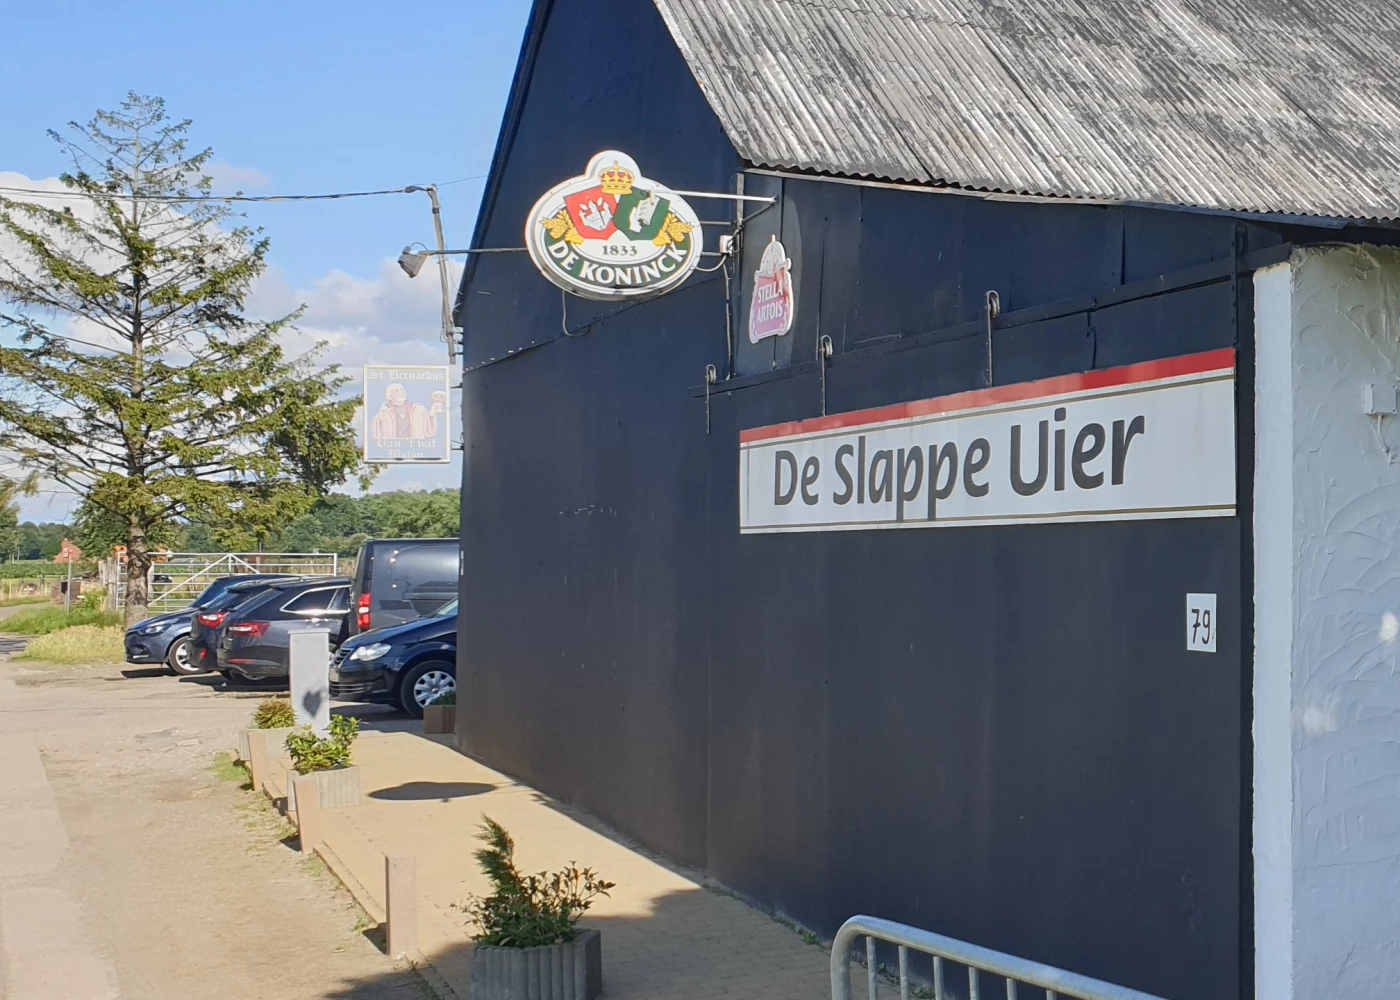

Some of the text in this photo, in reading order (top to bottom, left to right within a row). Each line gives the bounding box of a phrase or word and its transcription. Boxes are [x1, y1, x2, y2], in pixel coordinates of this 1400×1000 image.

[548, 240, 687, 285] DE KONINCK
[601, 245, 638, 256] 1833
[757, 279, 783, 304] STELLA
[756, 299, 783, 324] ARTOIS
[367, 369, 445, 380] St Bernardus
[773, 406, 1145, 522] De Slappe Uier
[1191, 608, 1211, 645] 79
